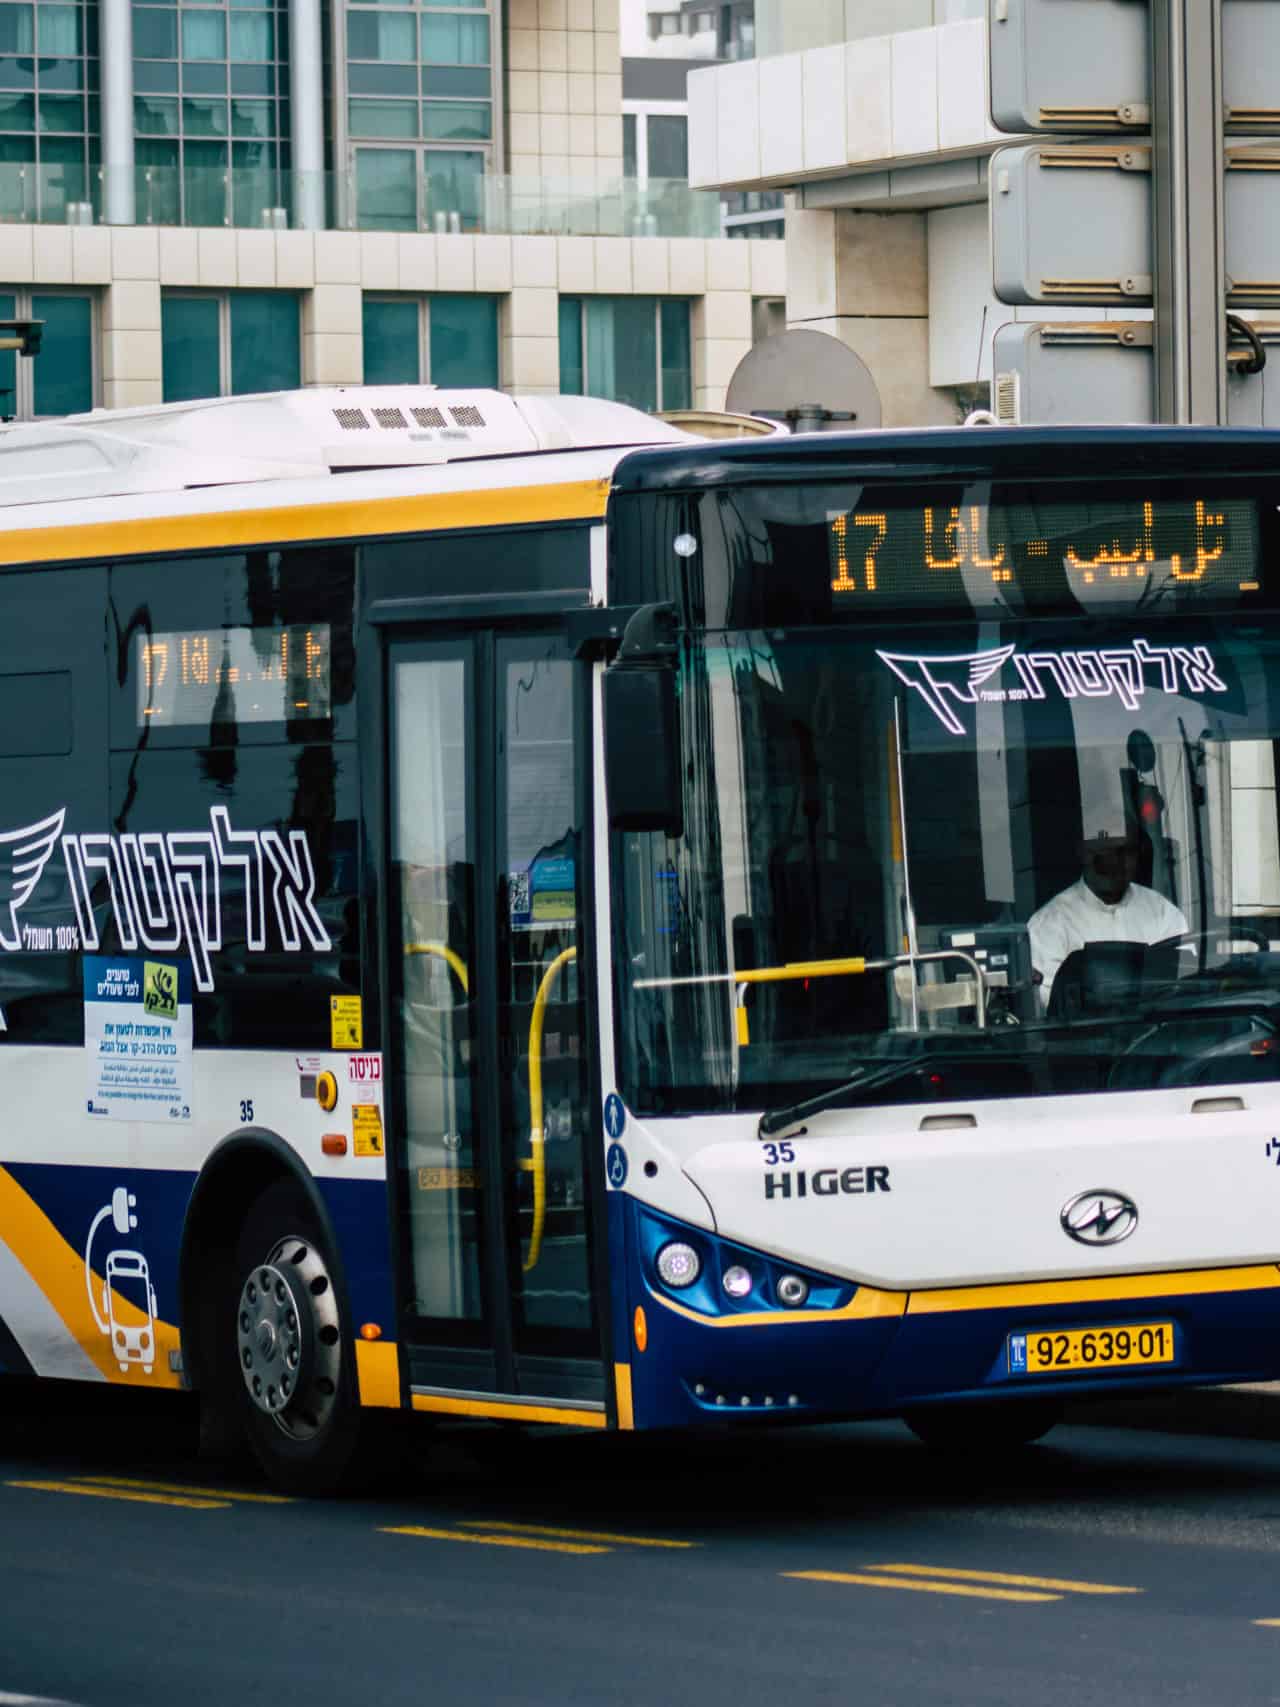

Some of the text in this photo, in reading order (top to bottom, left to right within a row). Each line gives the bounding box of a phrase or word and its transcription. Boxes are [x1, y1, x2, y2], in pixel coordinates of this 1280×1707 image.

[831, 513, 887, 591] 17
[924, 505, 1012, 582] يافا
[23, 923, 79, 950] 100% חשמלי
[349, 1055, 380, 1080] כניסה
[239, 1099, 254, 1122] 35
[762, 1141, 796, 1166] 35
[764, 1165, 892, 1200] HIGER
